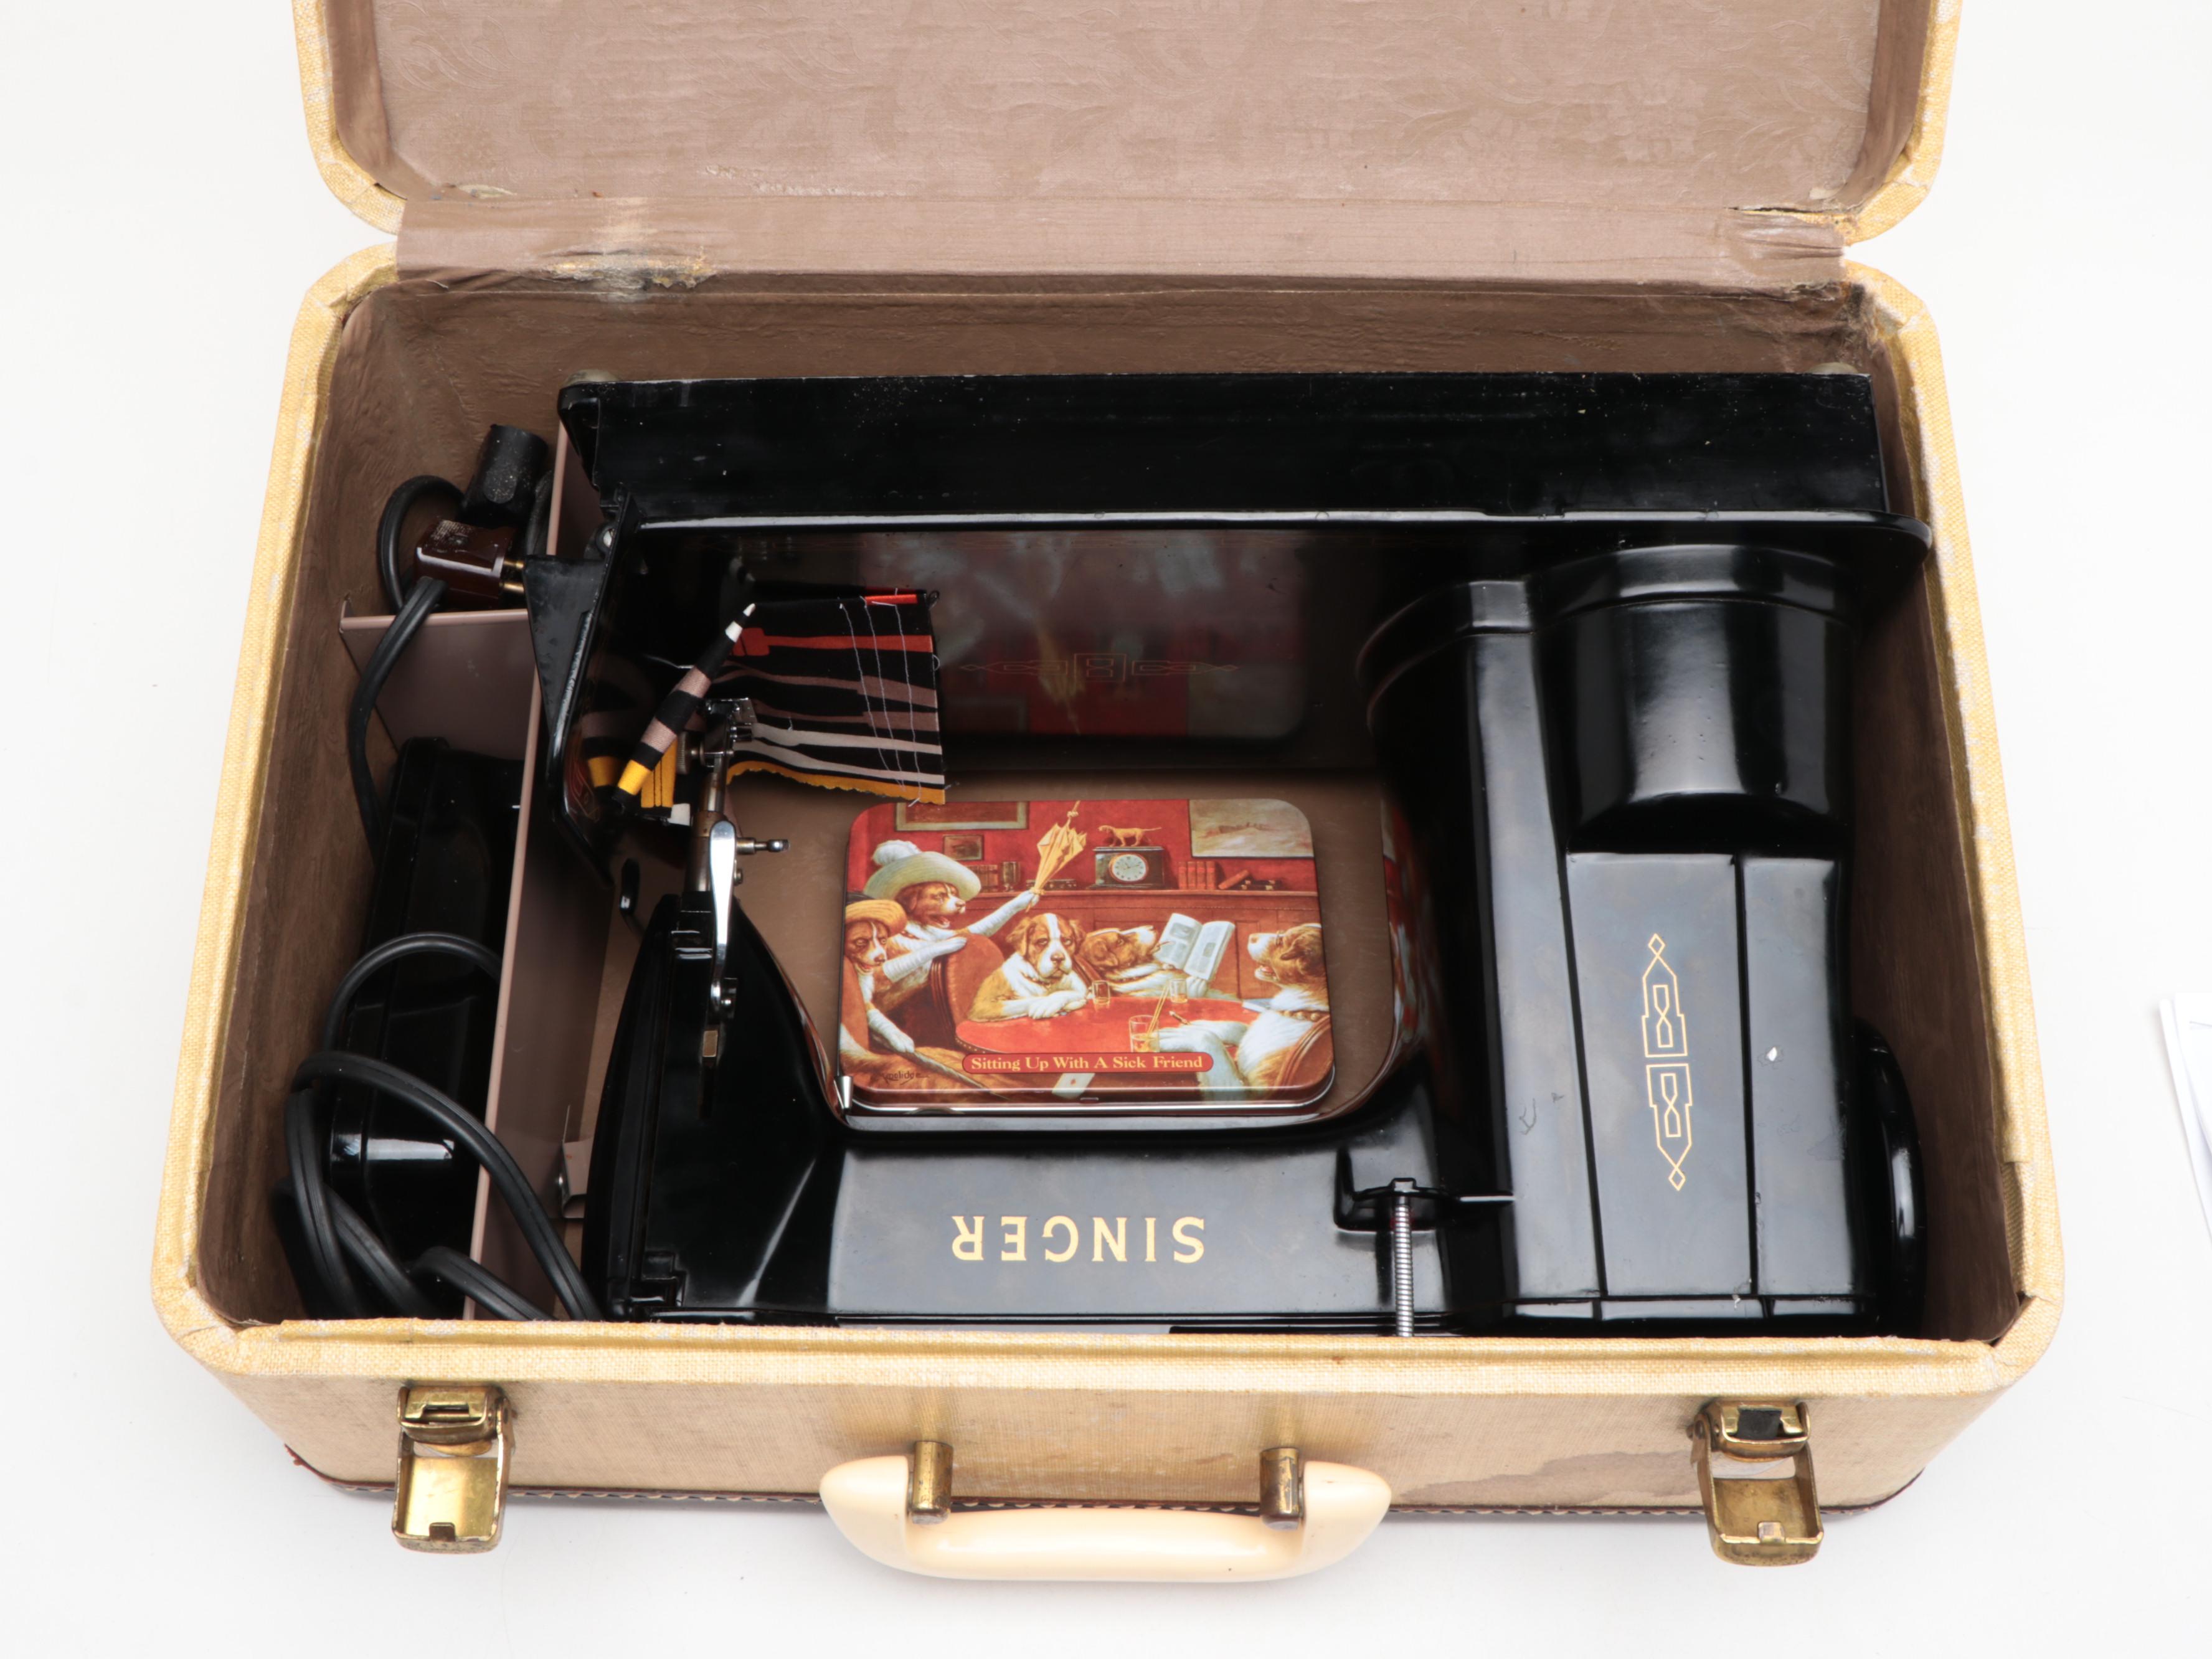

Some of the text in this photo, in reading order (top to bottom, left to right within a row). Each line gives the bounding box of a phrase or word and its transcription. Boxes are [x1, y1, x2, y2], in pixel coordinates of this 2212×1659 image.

[971, 1056, 1203, 1071] Sitting Up With A Sick Friend
[952, 1216, 1204, 1263] SINGER
